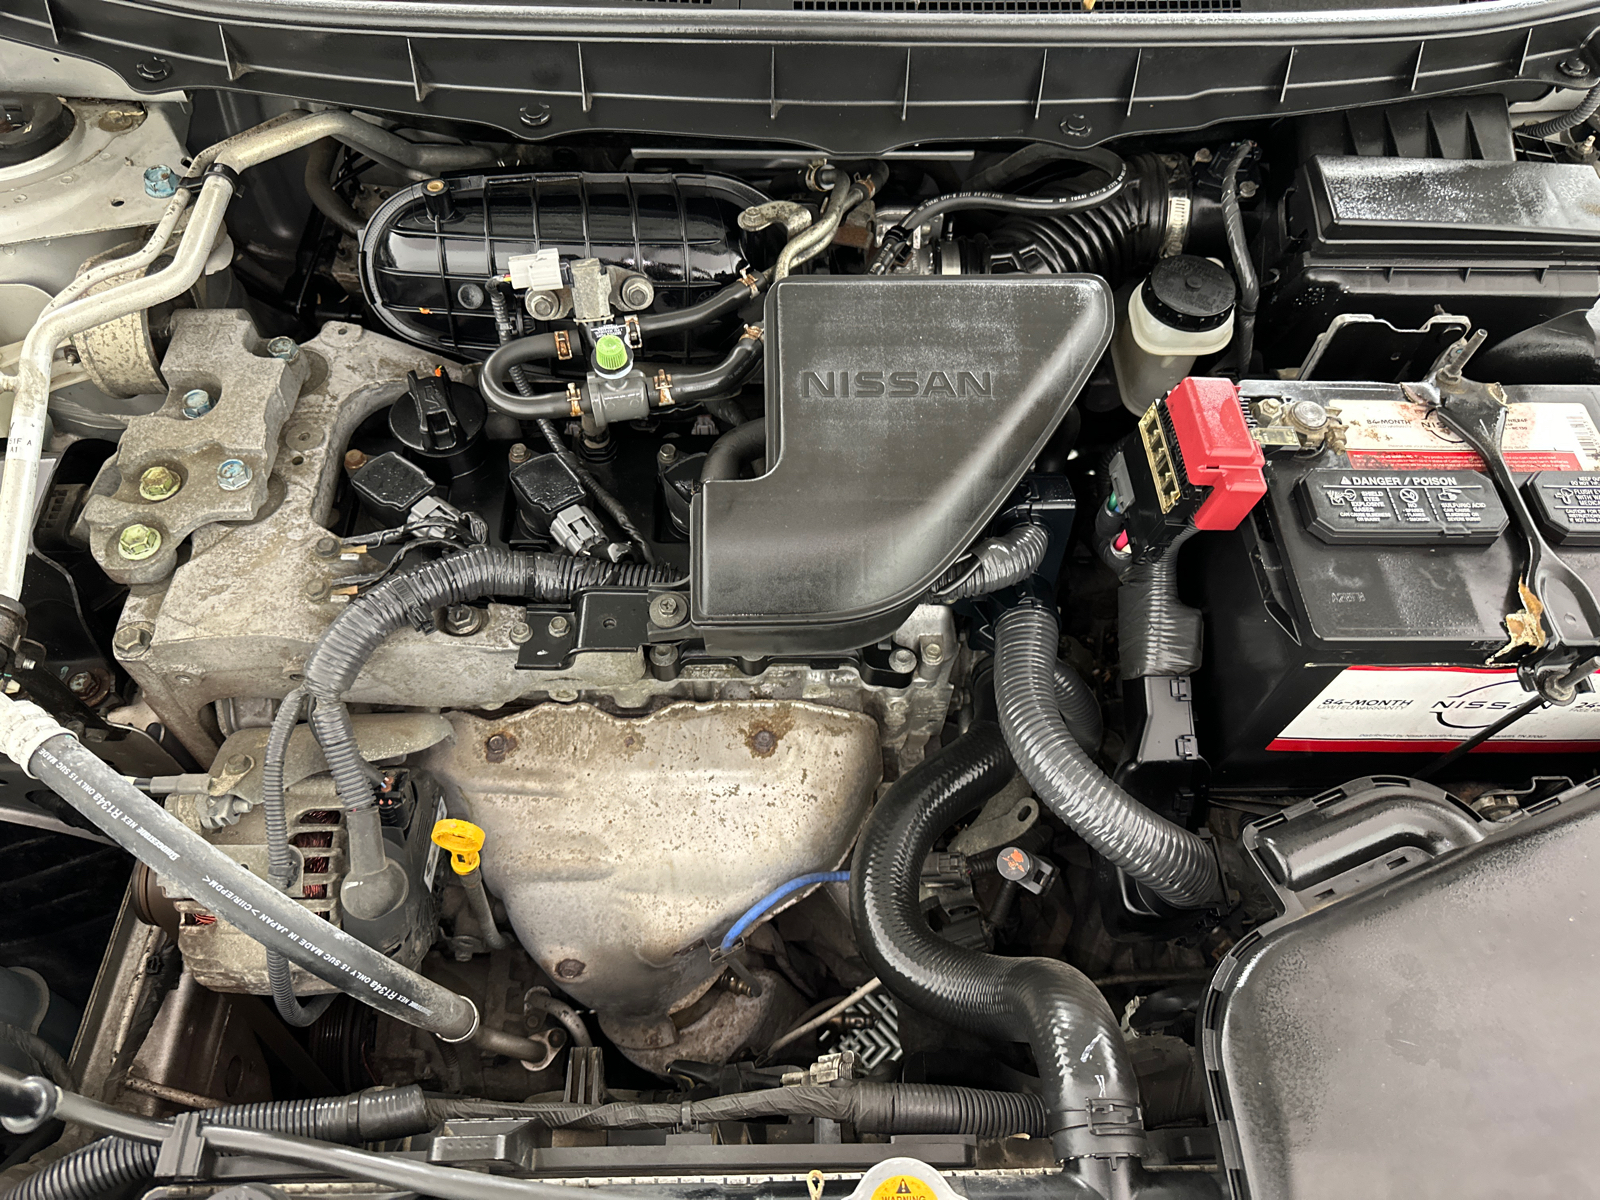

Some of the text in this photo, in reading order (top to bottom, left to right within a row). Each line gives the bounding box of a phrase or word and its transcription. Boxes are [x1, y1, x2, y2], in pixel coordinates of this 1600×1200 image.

[801, 371, 993, 398] NISSAN
[1352, 476, 1401, 486] DANGER
[1413, 476, 1457, 486] POISON
[1322, 698, 1414, 706] 84-MONTH
[38, 747, 59, 765] MADE
[55, 762, 71, 775] SUC
[68, 771, 79, 781] 15
[76, 779, 96, 795] ONLY
[93, 792, 123, 820] R134a
[121, 815, 138, 830] NEX
[258, 913, 289, 934] JAPAN
[288, 930, 299, 942] IN
[298, 938, 325, 956] MADE
[322, 951, 342, 967] SUC
[339, 962, 352, 972] 15
[349, 969, 371, 984] ONLY
[369, 978, 400, 1001] R134a
